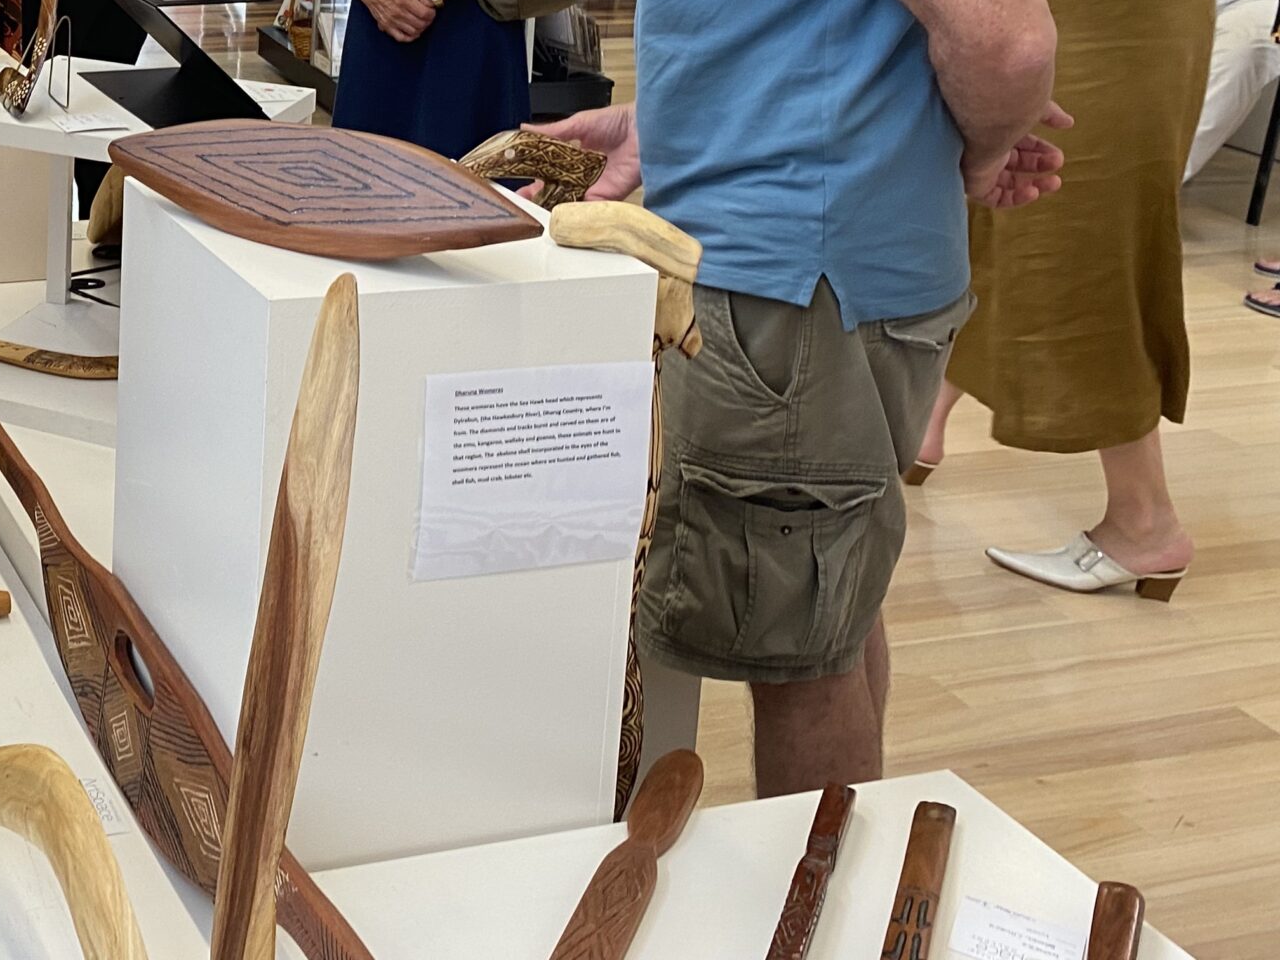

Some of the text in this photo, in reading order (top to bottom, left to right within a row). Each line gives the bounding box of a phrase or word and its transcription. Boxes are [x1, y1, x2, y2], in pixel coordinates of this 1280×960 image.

[575, 394, 603, 402] represents
[492, 412, 524, 420] Hawkesbury
[480, 426, 505, 434] diamonds
[531, 445, 564, 453] incorporated
